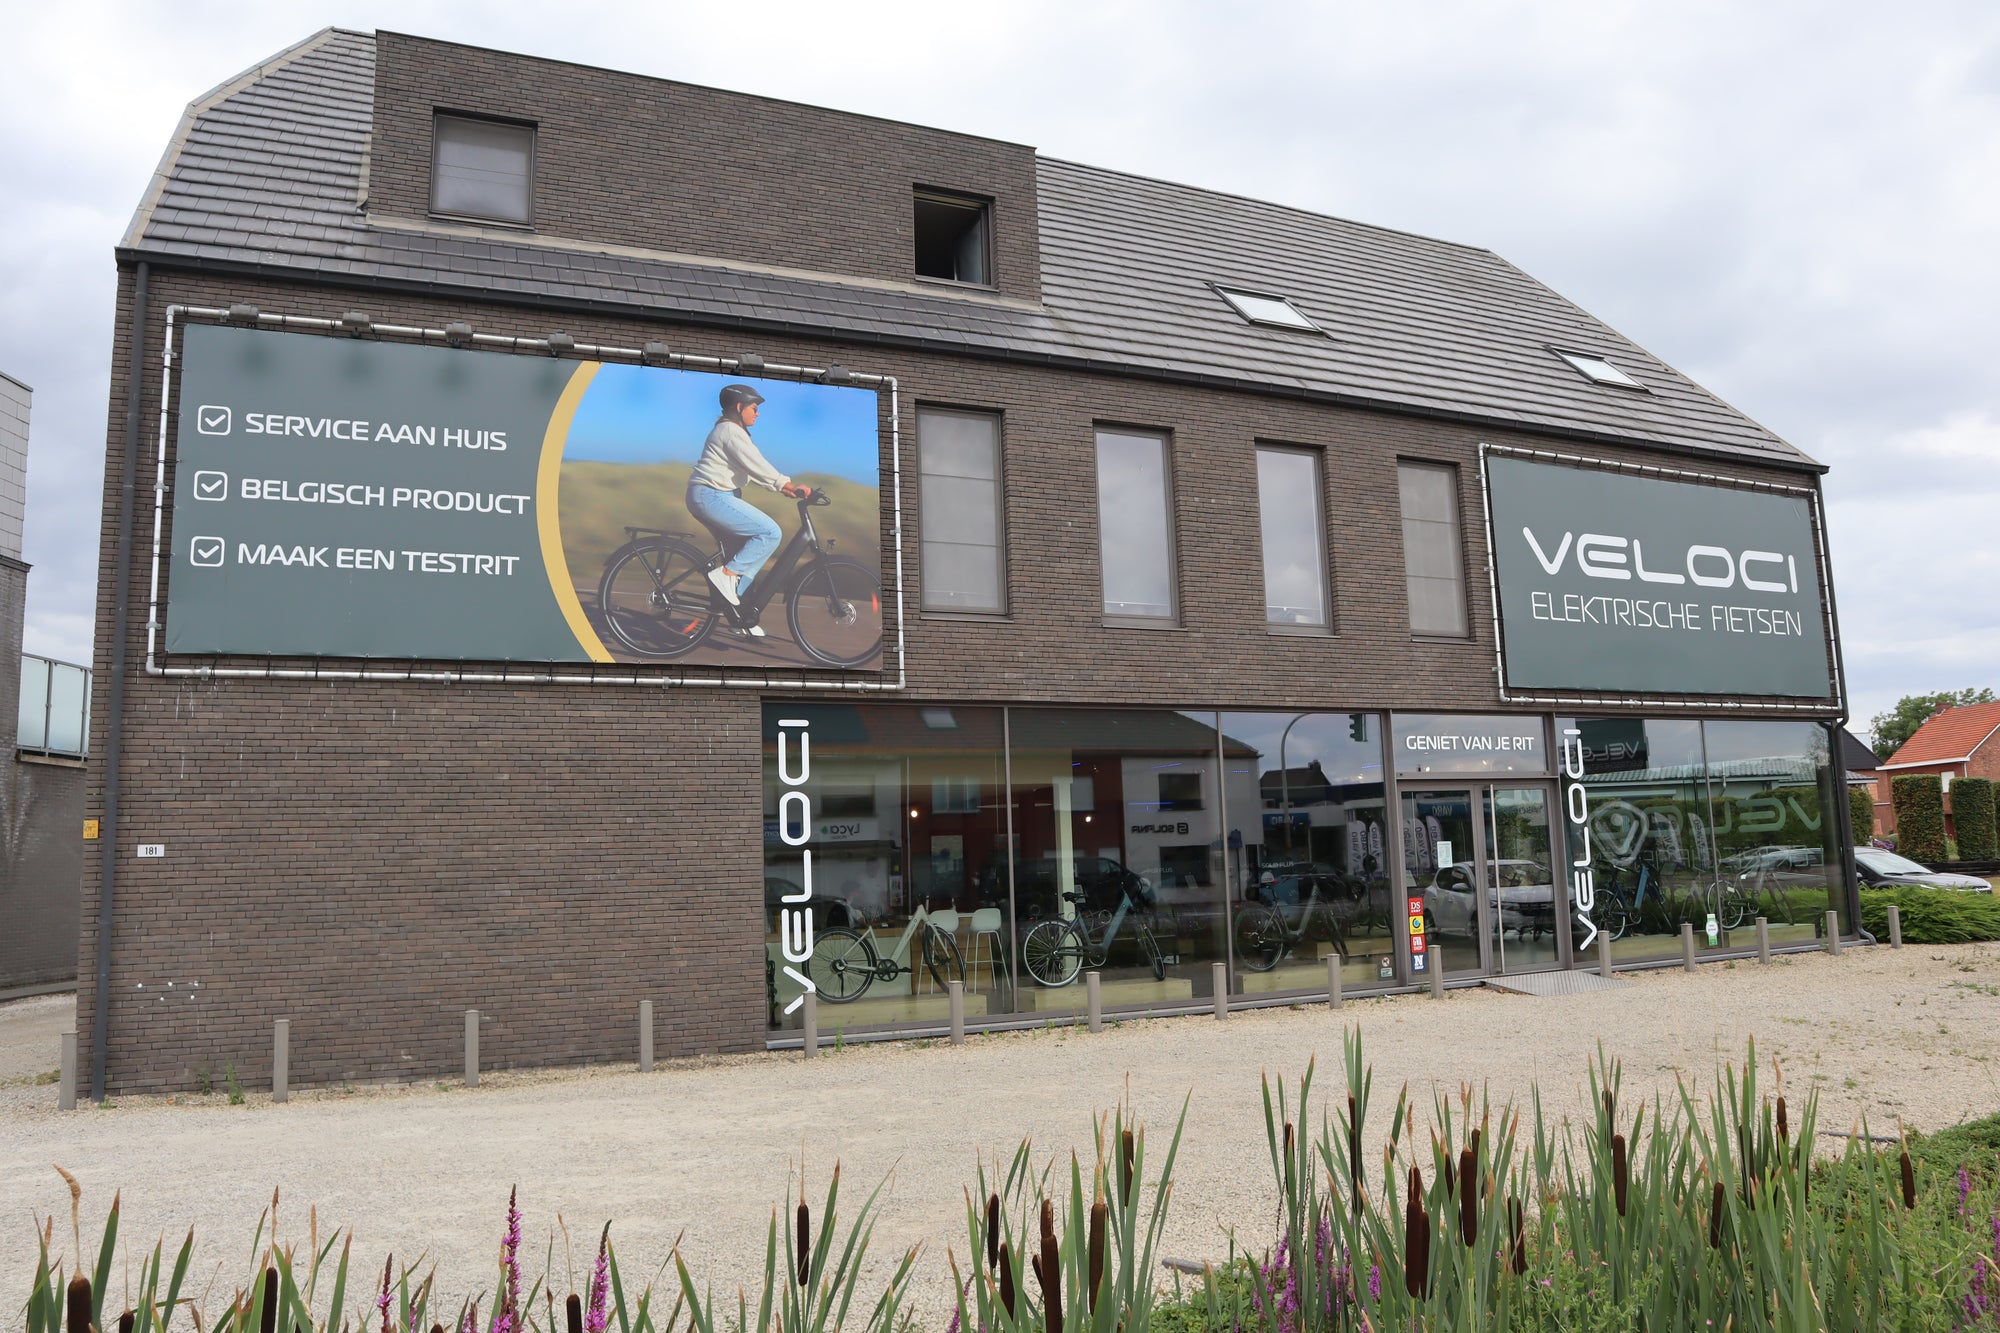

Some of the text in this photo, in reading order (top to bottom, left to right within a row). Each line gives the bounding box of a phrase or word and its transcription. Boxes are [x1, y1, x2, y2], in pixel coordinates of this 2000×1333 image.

[245, 412, 507, 451] SERVICE AAN HUIS
[241, 478, 531, 515] BELGISCH PRODUCT
[237, 542, 520, 576] MAAK EEN TESTRIT
[1522, 526, 1798, 594] VELOCI
[1531, 591, 1802, 637] ELEKTRISCHE FIETSEN
[1406, 735, 1535, 751] GENIET VAN JE RIT
[145, 846, 158, 856] 181
[1563, 729, 1597, 951] VELOCI
[778, 719, 816, 1015] VELOCI
[1410, 901, 1421, 910] DS
